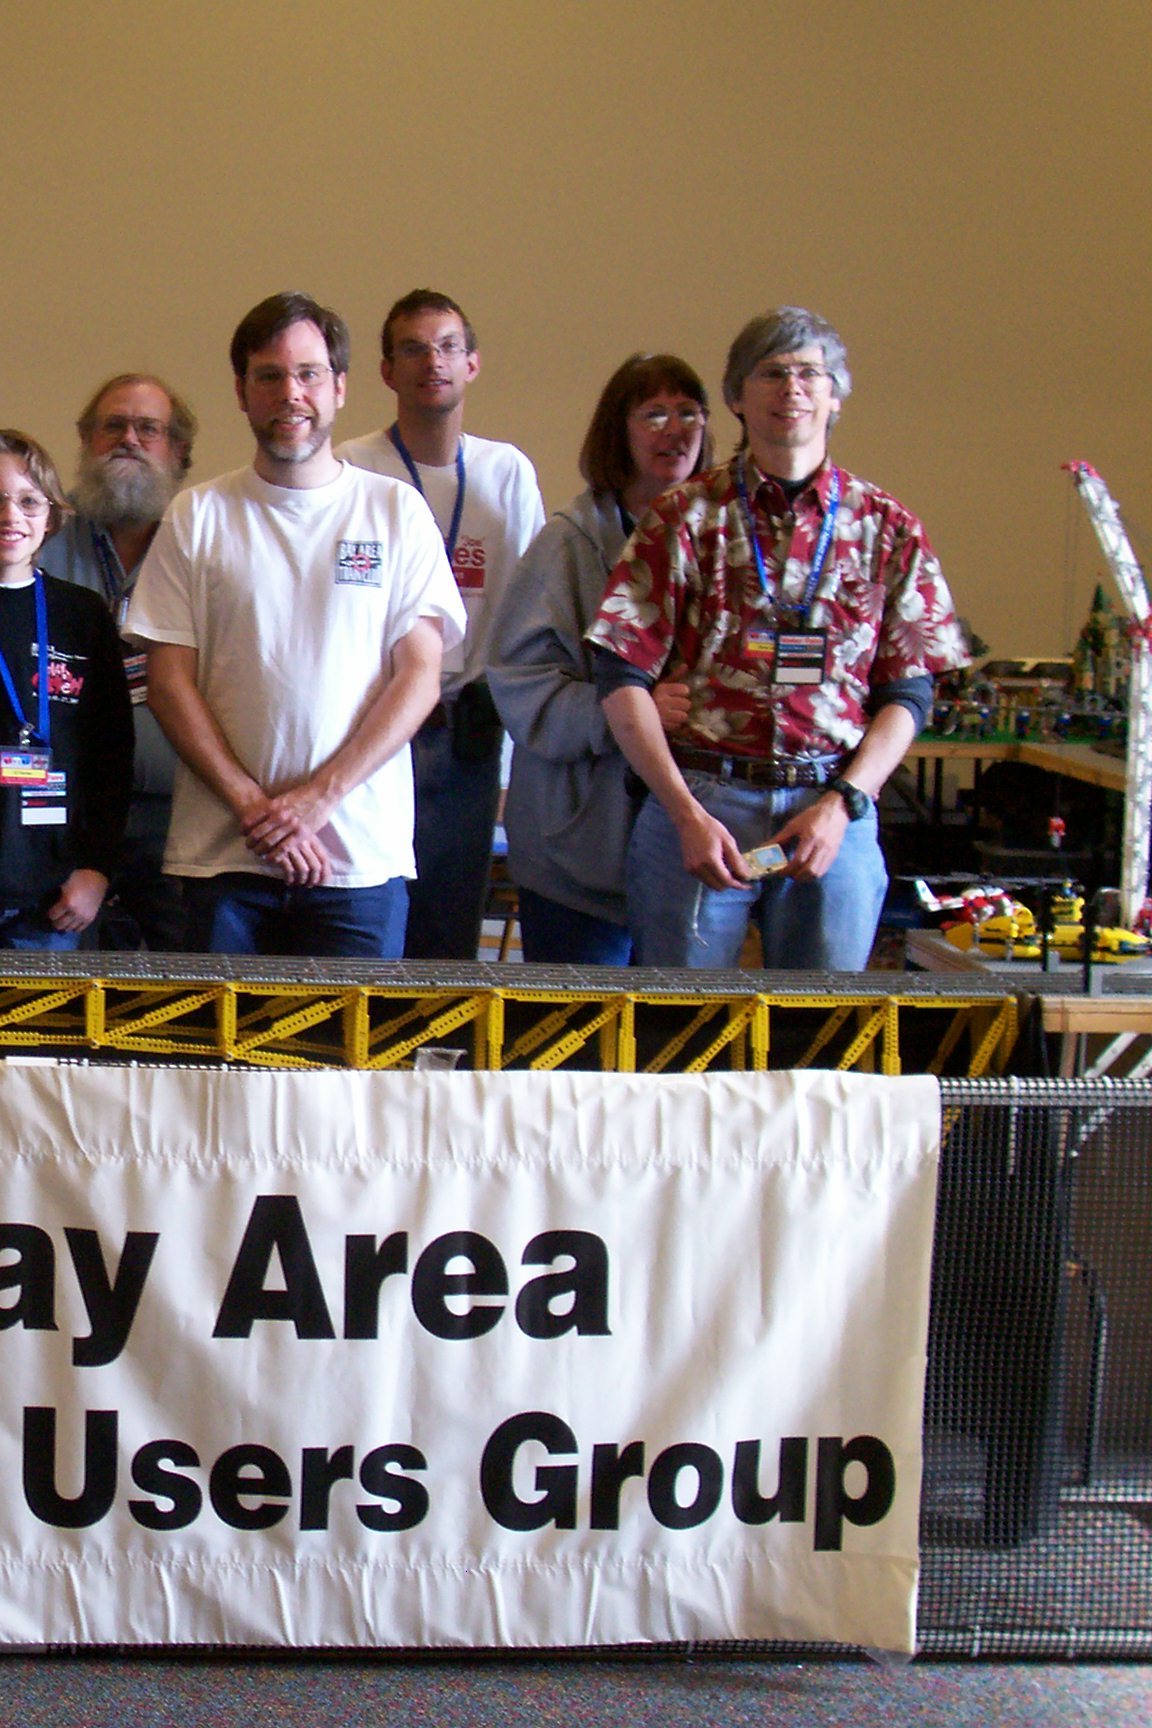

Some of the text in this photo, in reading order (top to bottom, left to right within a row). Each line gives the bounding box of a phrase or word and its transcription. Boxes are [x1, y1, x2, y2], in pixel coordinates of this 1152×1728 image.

[212, 1195, 611, 1340] Area
[22, 1406, 429, 1532] Users
[480, 1411, 895, 1552] Group
